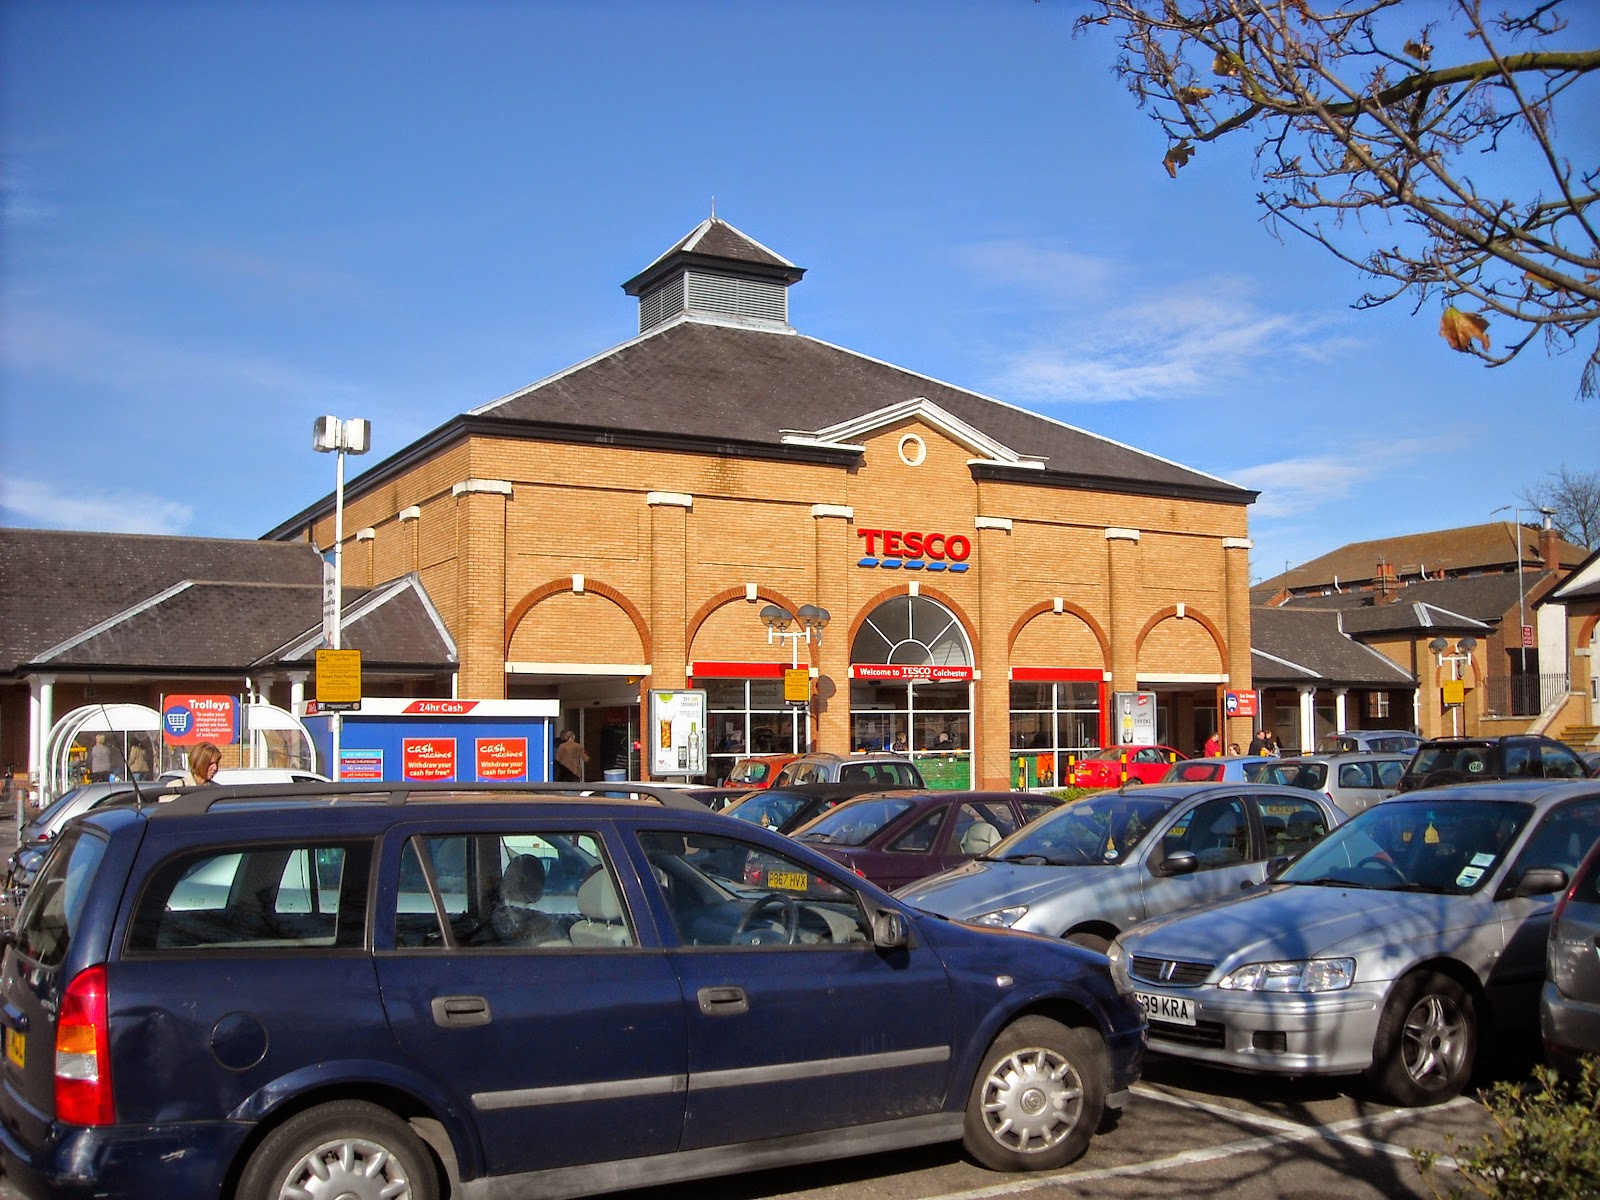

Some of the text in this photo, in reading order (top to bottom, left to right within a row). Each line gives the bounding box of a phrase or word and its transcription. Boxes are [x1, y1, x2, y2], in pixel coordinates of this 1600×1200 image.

[857, 528, 971, 561] TESCO
[859, 668, 892, 677] Welcome
[895, 668, 900, 676] to
[933, 669, 967, 678] Colchester
[189, 699, 230, 711] Trolleys
[419, 703, 463, 712] 24hr Cash
[407, 743, 433, 753] cash
[480, 743, 505, 753] cash
[769, 873, 805, 887] P867 HVX
[1161, 997, 1188, 1018] KRA
